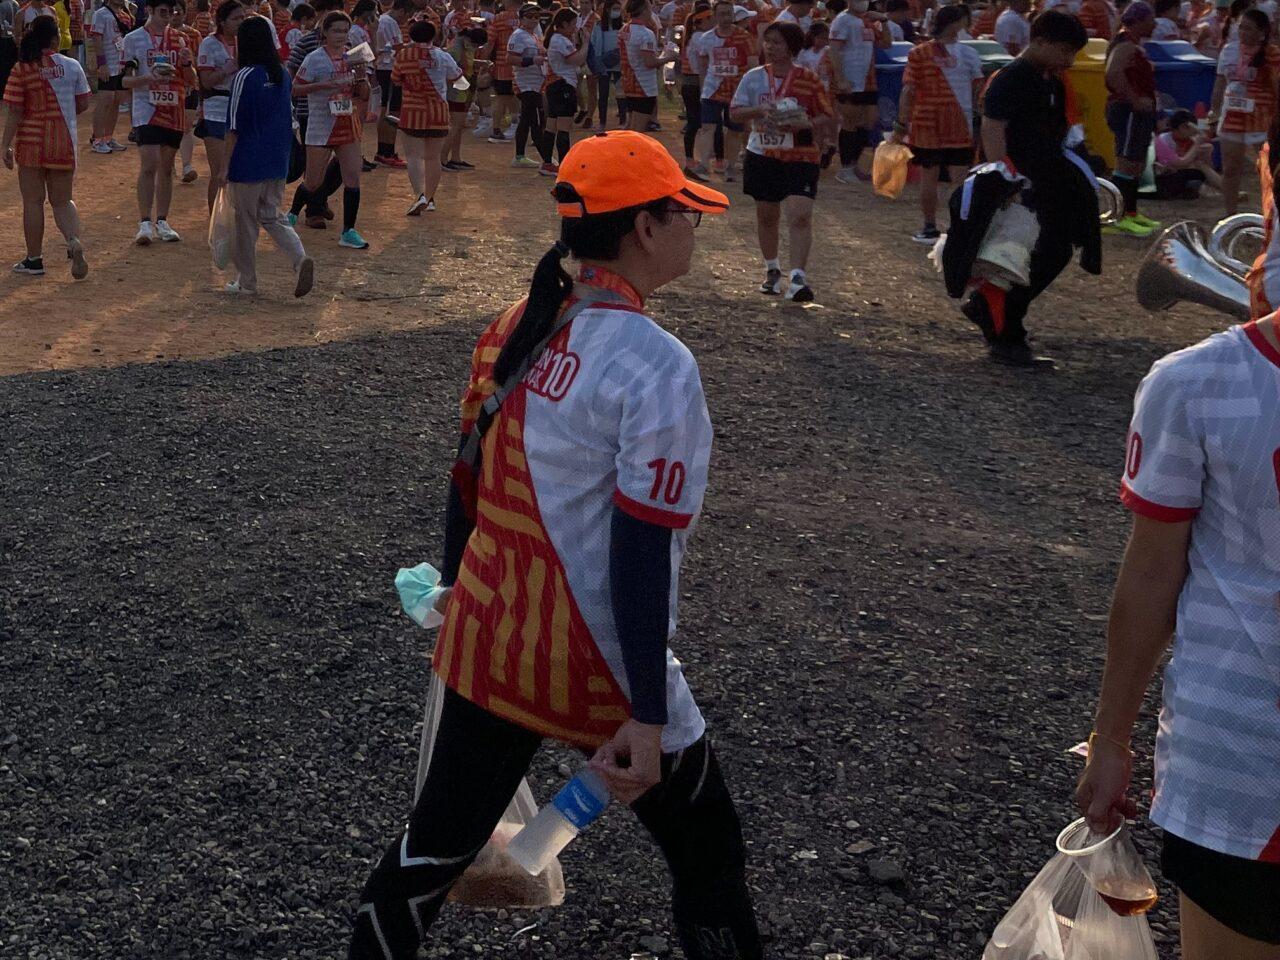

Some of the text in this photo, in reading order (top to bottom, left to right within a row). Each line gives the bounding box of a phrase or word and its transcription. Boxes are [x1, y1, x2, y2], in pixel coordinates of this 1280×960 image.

[152, 92, 174, 101] 1750
[542, 352, 577, 398] 10
[1128, 432, 1143, 480] 0
[648, 457, 686, 505] 10
